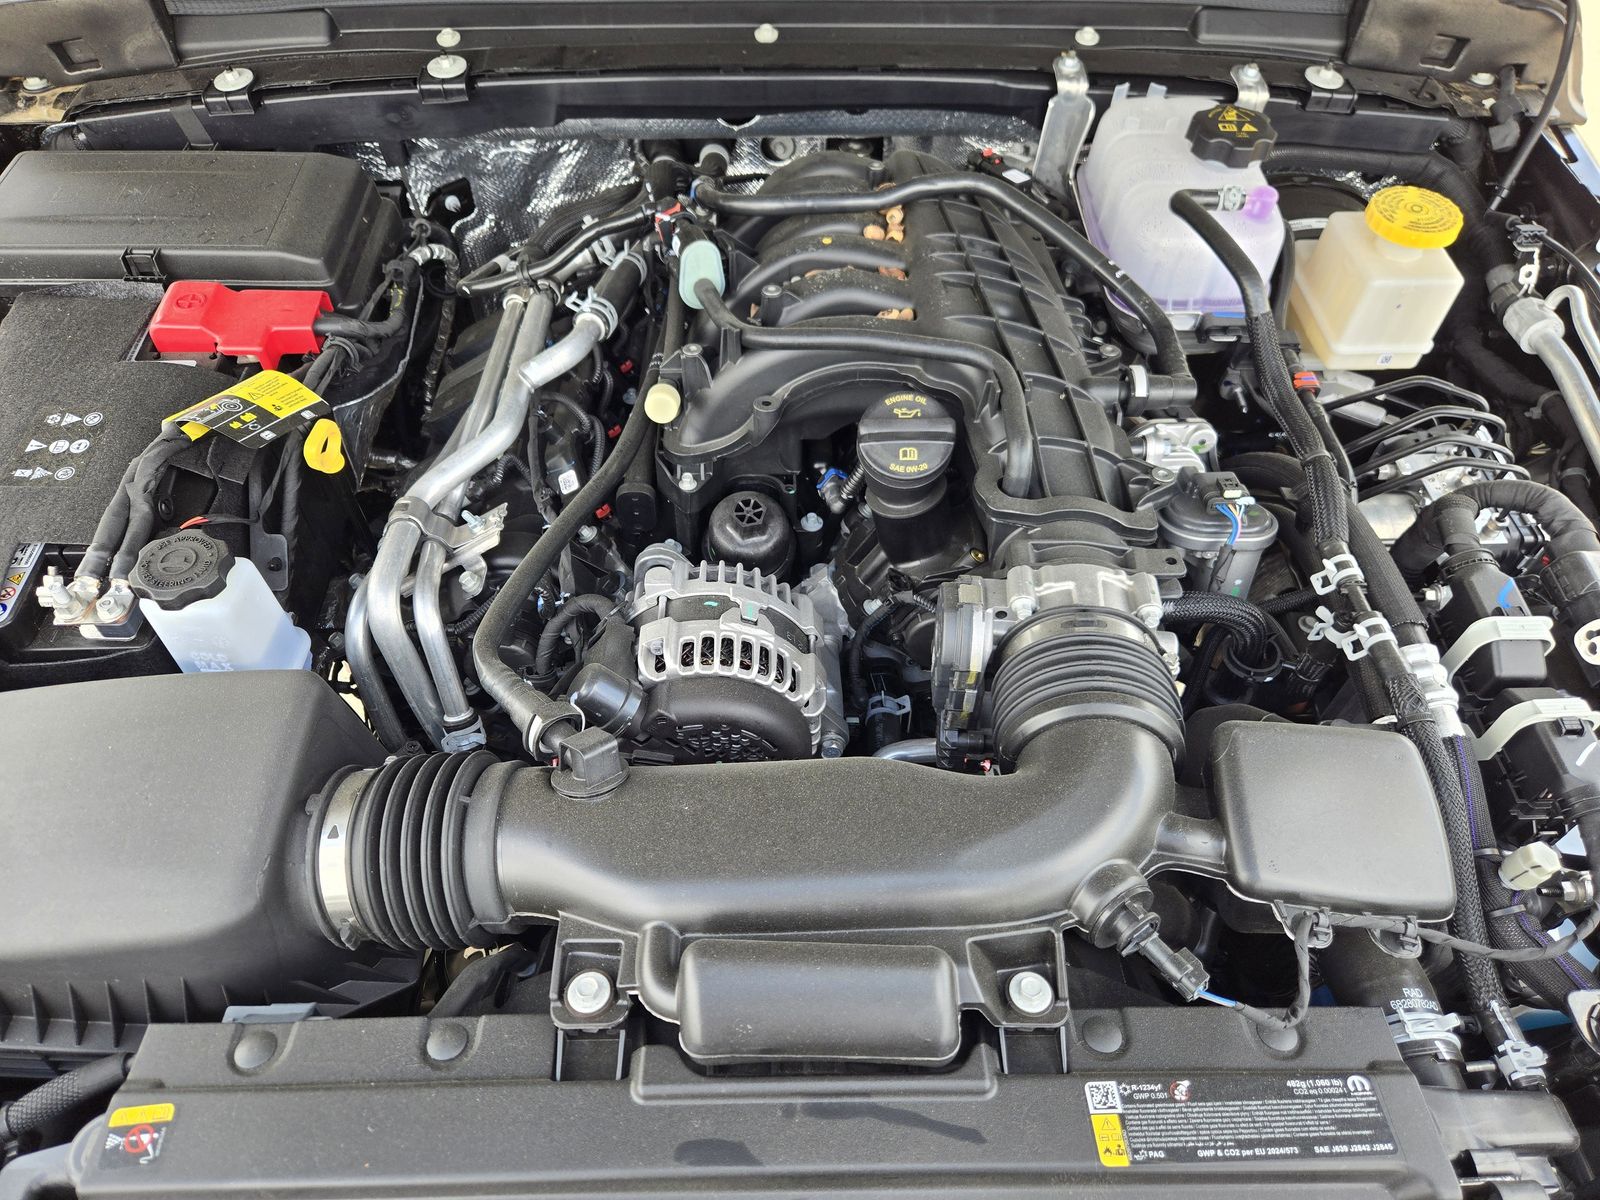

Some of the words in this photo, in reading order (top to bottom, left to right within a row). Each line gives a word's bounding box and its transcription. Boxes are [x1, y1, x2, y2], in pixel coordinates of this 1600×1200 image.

[884, 394, 914, 406] ENGINE
[914, 395, 928, 405] OIL
[889, 463, 905, 473] SAE
[905, 463, 928, 473] 0W-20
[174, 535, 212, 551] APPROVED
[150, 576, 193, 588] STEERING
[1402, 987, 1423, 998] RAD
[1131, 1083, 1161, 1092] R-1234yf
[1309, 1088, 1318, 1096] eq
[1133, 1092, 1150, 1100] GWP
[1148, 1150, 1165, 1158] PAG
[1197, 1149, 1215, 1157] GWP
[1217, 1149, 1224, 1157] &
[1241, 1149, 1254, 1157] per
[1254, 1148, 1266, 1156] EU
[1266, 1147, 1299, 1155] 2024/573
[1313, 1145, 1331, 1154] SAE
